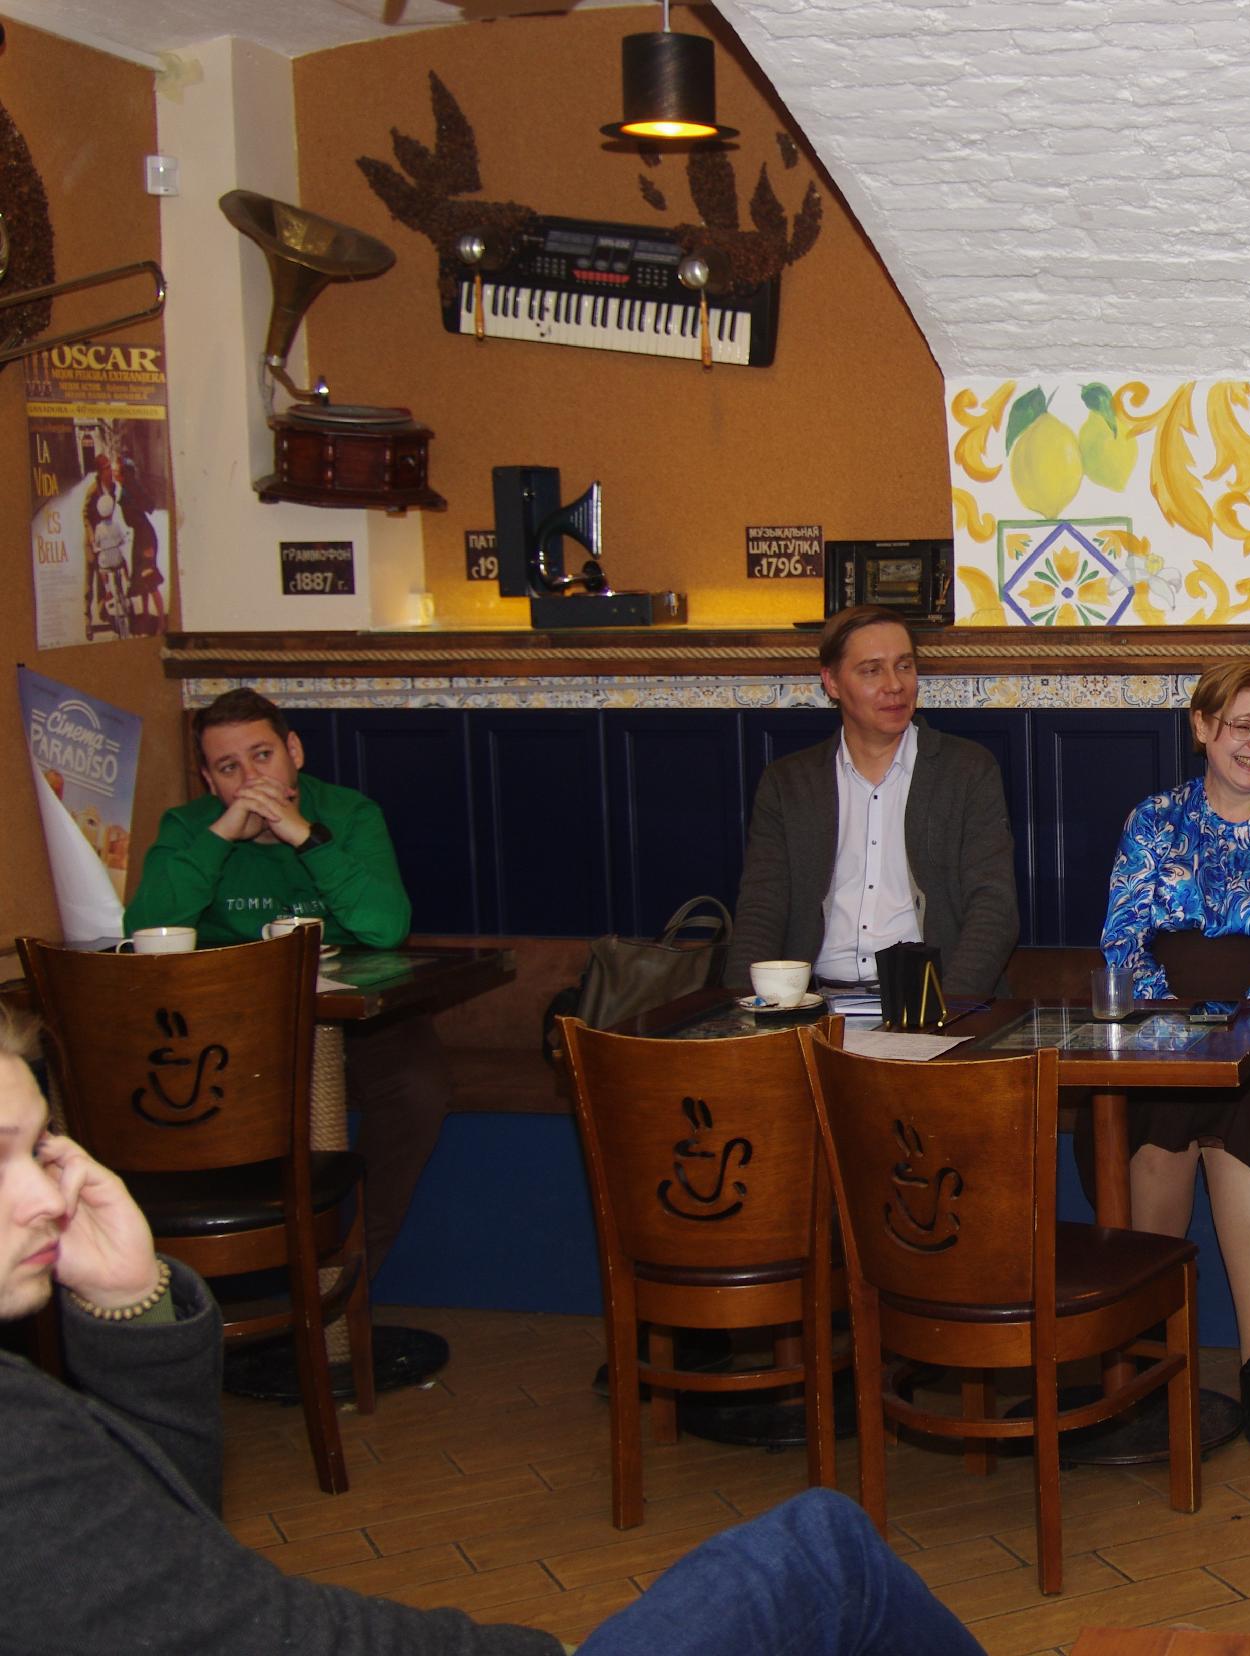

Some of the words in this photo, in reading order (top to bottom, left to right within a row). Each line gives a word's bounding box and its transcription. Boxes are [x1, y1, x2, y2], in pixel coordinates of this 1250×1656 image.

[51, 345, 161, 372] OSCAR
[36, 433, 51, 464] LA
[33, 468, 60, 496] VIDA
[469, 535, 496, 549] ПАТ
[749, 527, 819, 538] МУЗЫКАЛЬНАЯ
[37, 536, 69, 564] BELLA
[749, 540, 820, 556] ШКАТУЛКА
[47, 711, 105, 750] Cinema
[227, 897, 274, 911] TOMM
